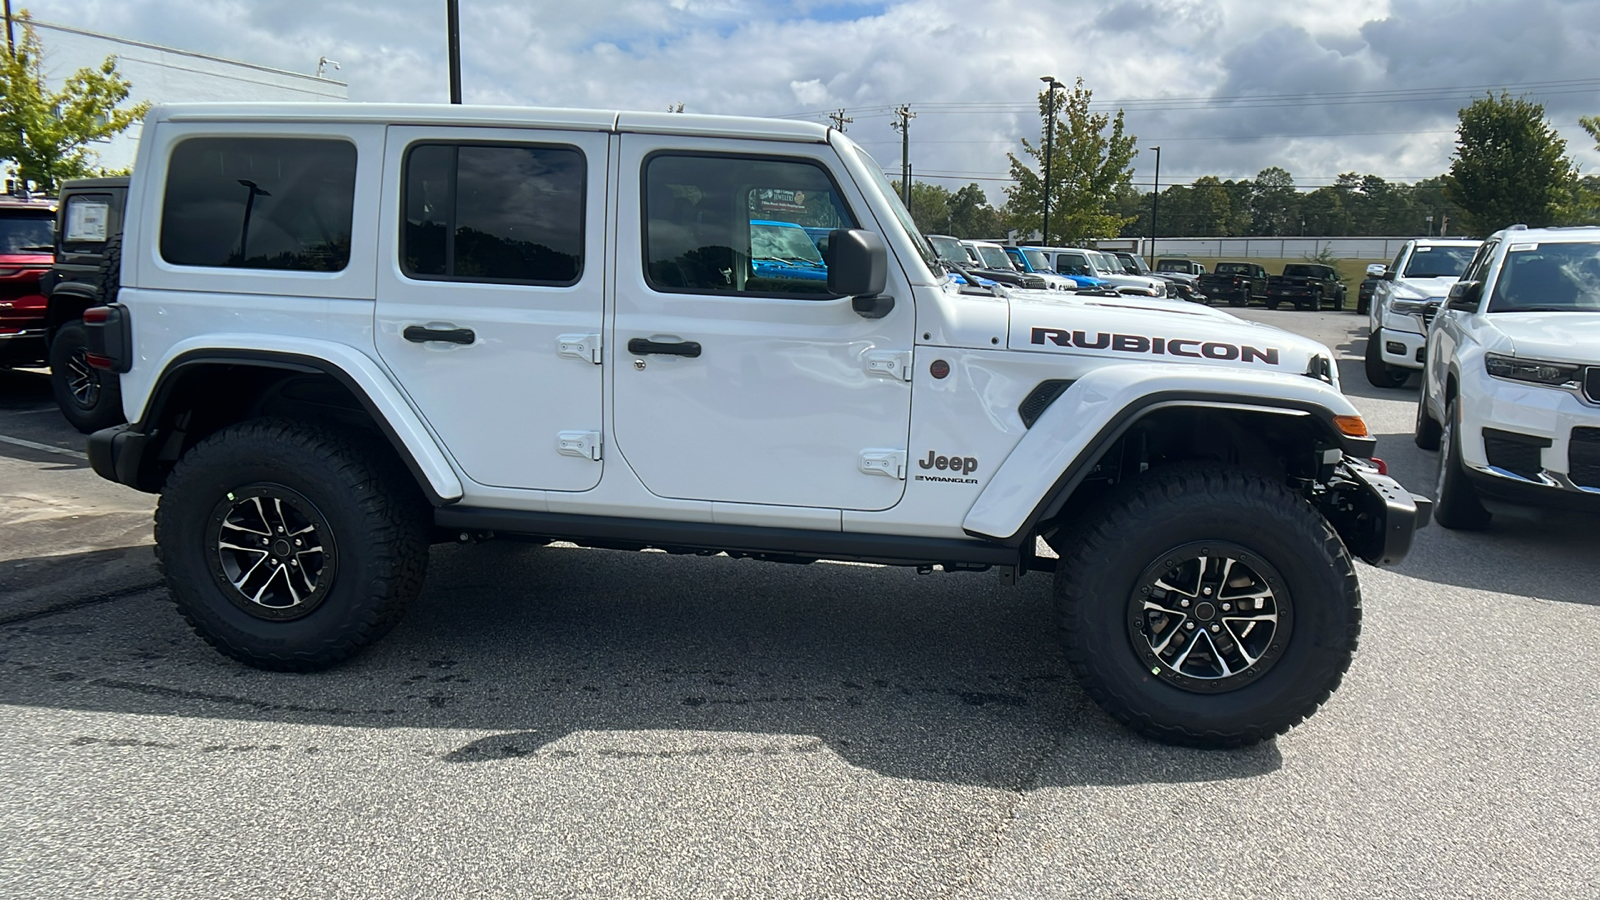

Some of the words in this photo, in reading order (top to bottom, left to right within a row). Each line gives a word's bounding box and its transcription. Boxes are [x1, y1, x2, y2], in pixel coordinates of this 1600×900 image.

[1031, 327, 1279, 365] RUBICON
[919, 450, 978, 475] Jeep
[925, 475, 978, 484] WRANGLER
